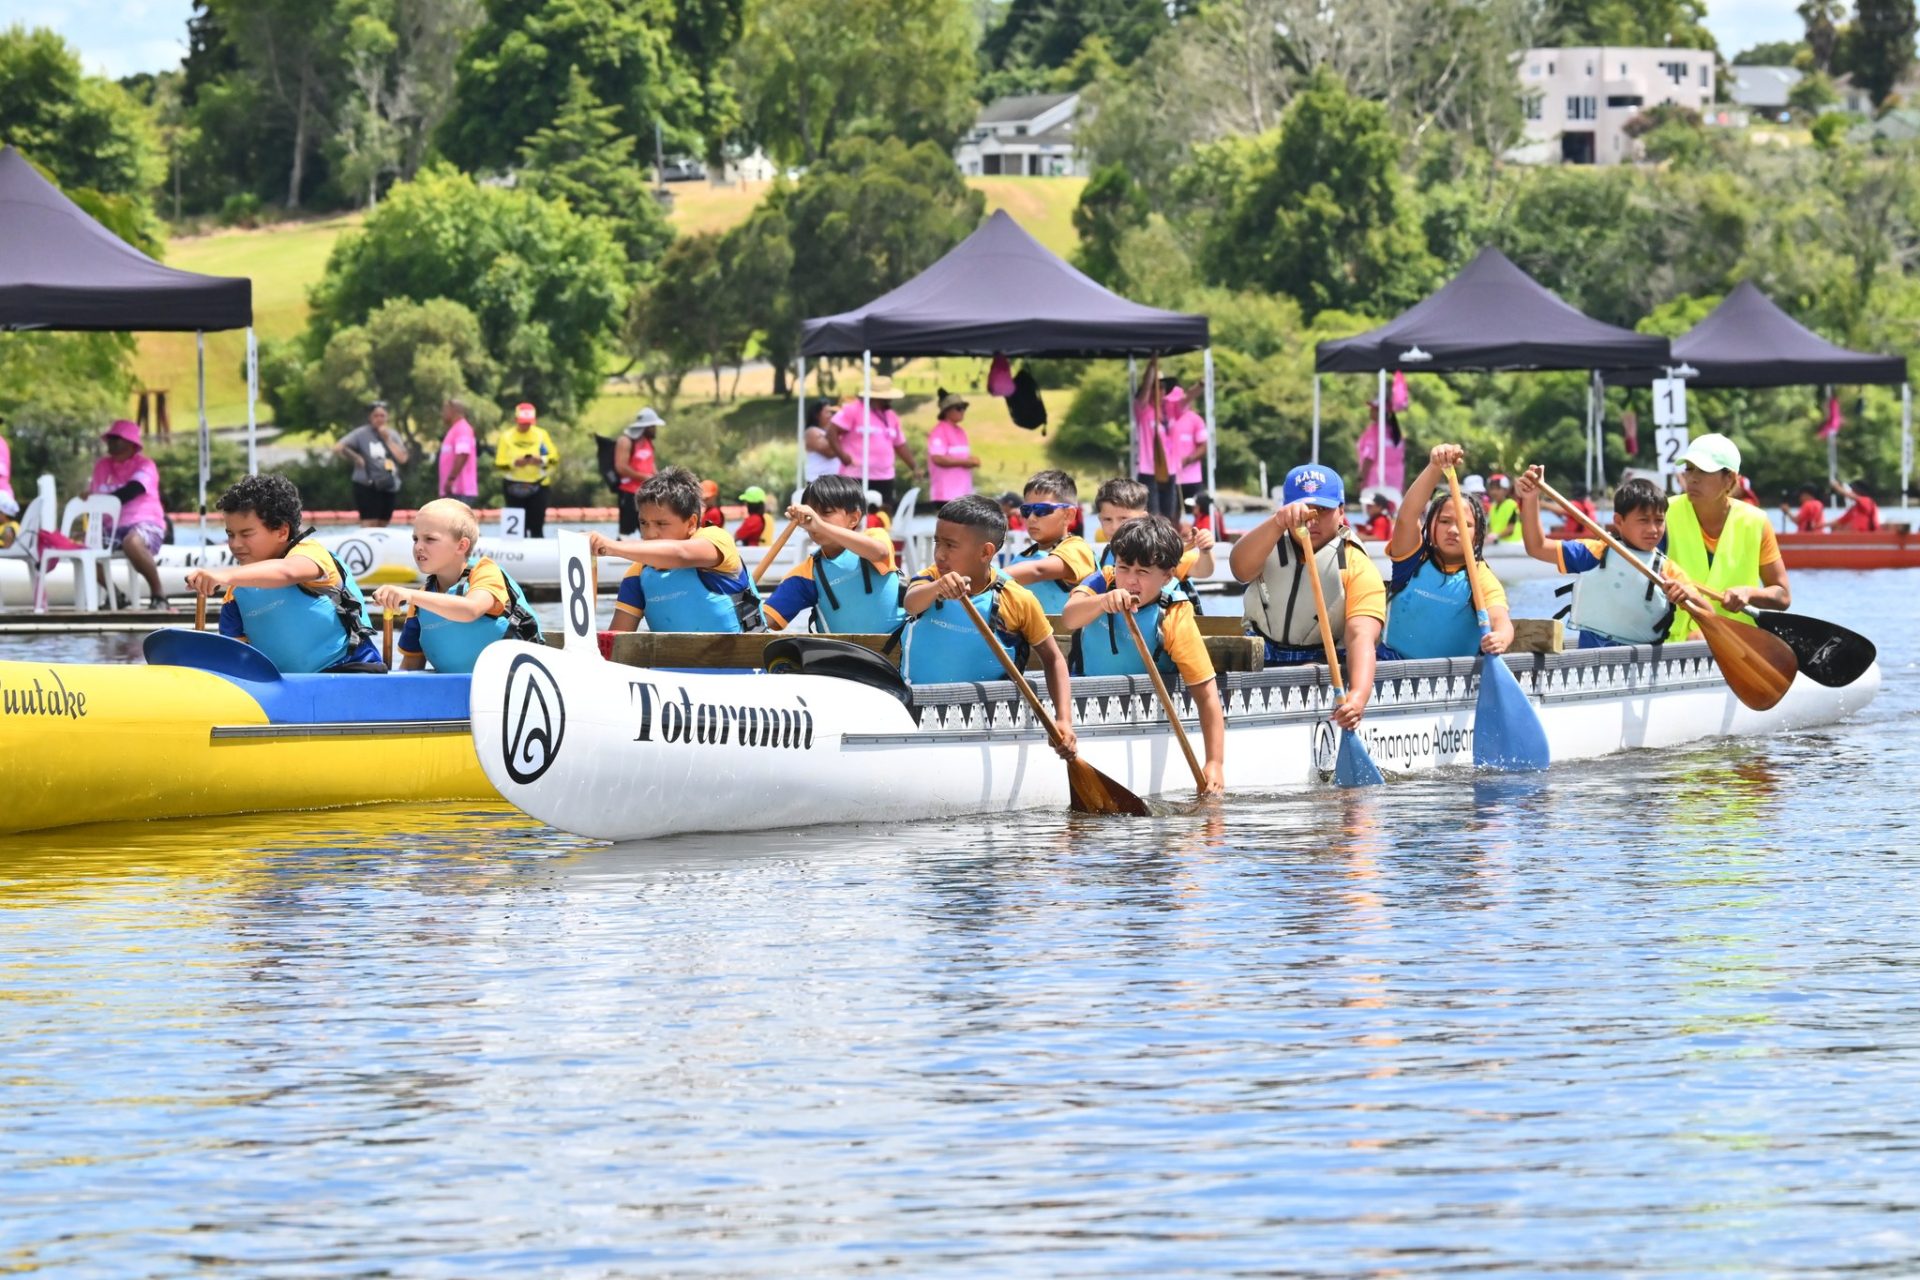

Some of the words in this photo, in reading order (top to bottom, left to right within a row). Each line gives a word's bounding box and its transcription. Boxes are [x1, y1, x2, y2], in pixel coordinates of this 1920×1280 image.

[1662, 388, 1674, 415] 1
[1665, 437, 1681, 464] 2
[506, 515, 520, 535] 2
[567, 556, 590, 638] 8
[628, 681, 817, 751] Totaranui
[1421, 732, 1431, 756] o
